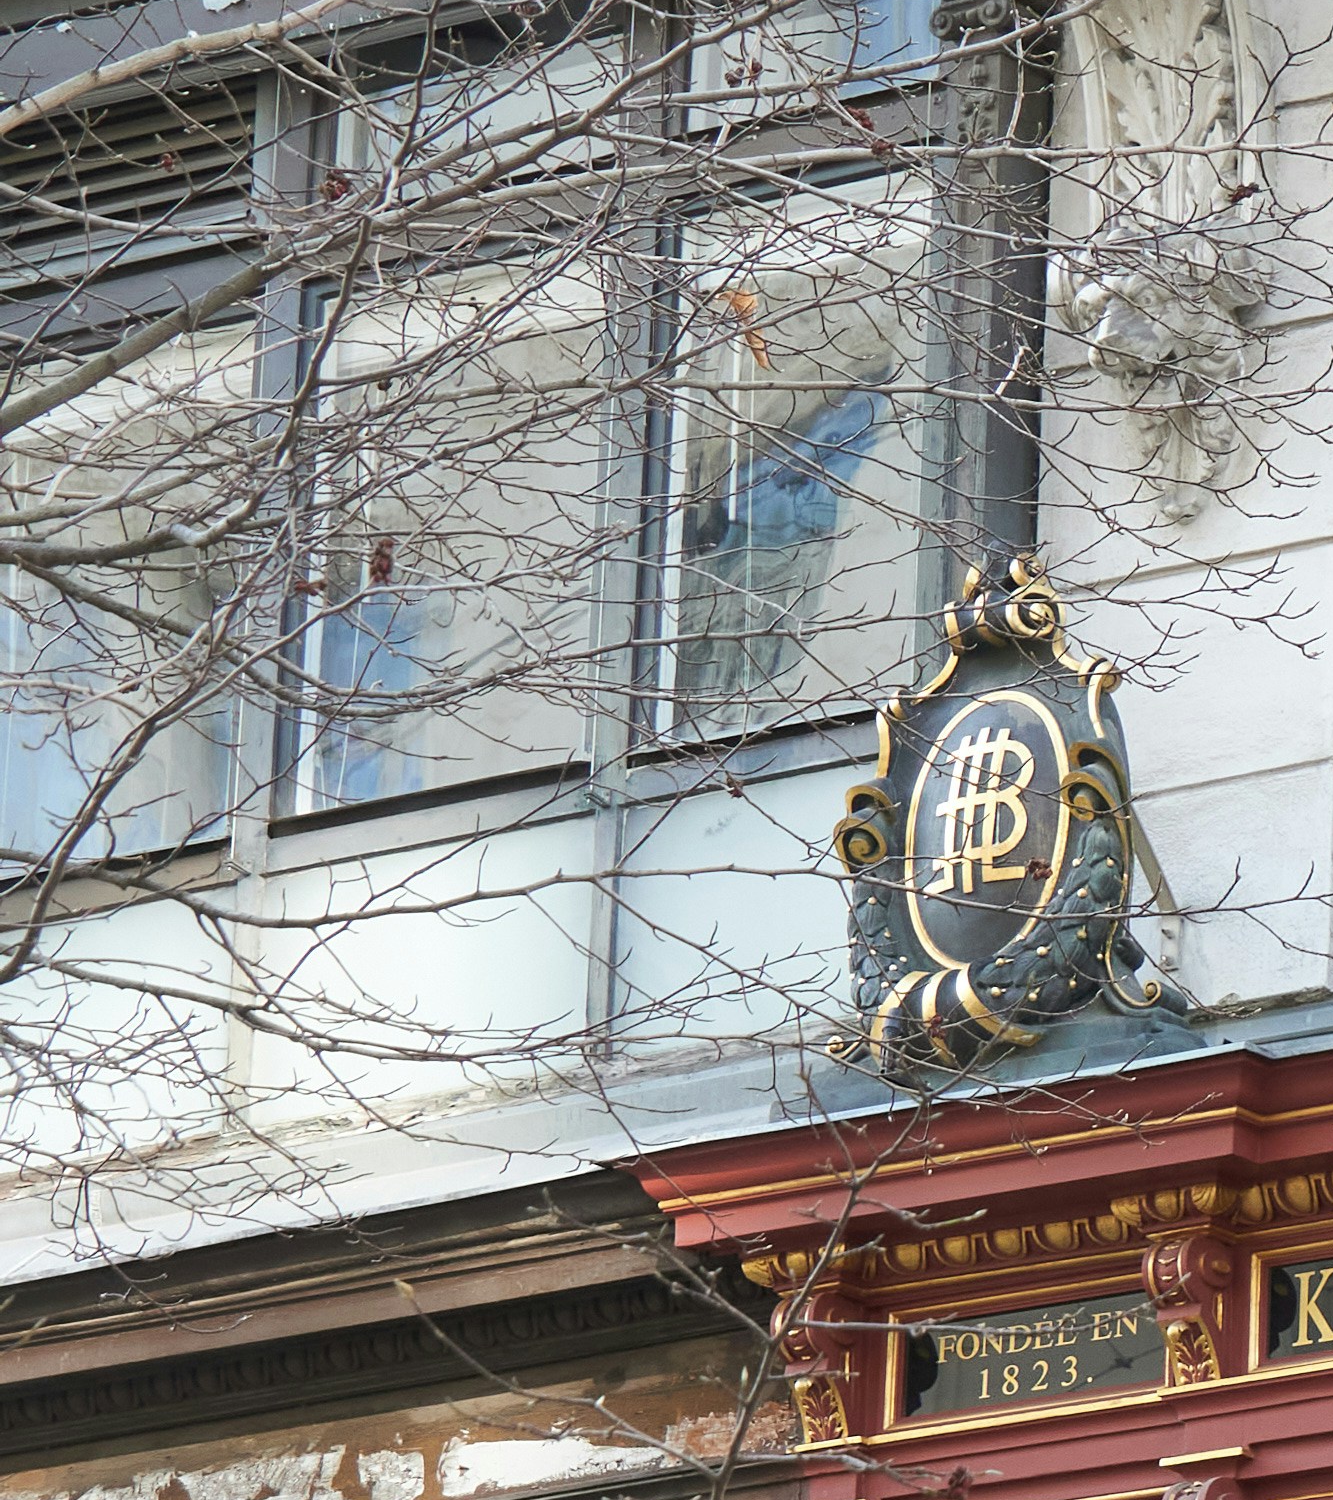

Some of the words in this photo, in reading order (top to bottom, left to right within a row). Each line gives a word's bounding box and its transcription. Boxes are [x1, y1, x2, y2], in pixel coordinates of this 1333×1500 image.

[936, 1313, 1079, 1364] FONDÉE
[1091, 1310, 1139, 1343] EN
[978, 1354, 1094, 1400] 1823.
